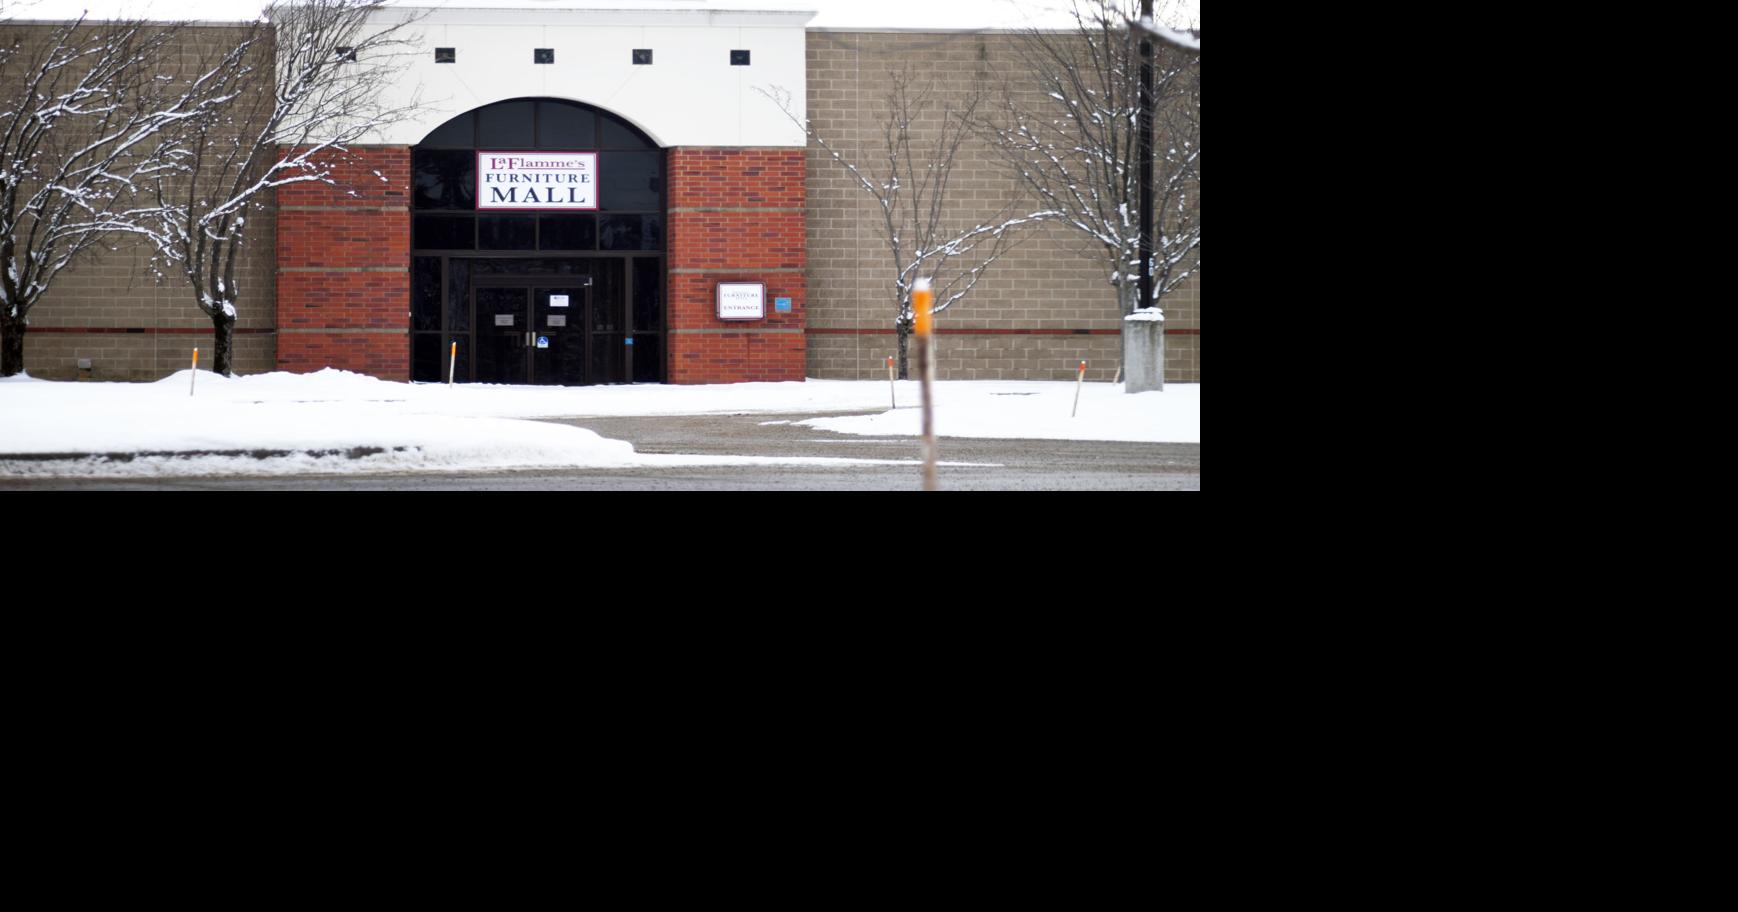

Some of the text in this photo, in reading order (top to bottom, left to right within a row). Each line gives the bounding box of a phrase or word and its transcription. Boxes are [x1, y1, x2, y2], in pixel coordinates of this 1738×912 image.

[490, 157, 585, 170] LaFlamme's
[486, 173, 590, 183] FURNITURE
[490, 186, 585, 203] MALL
